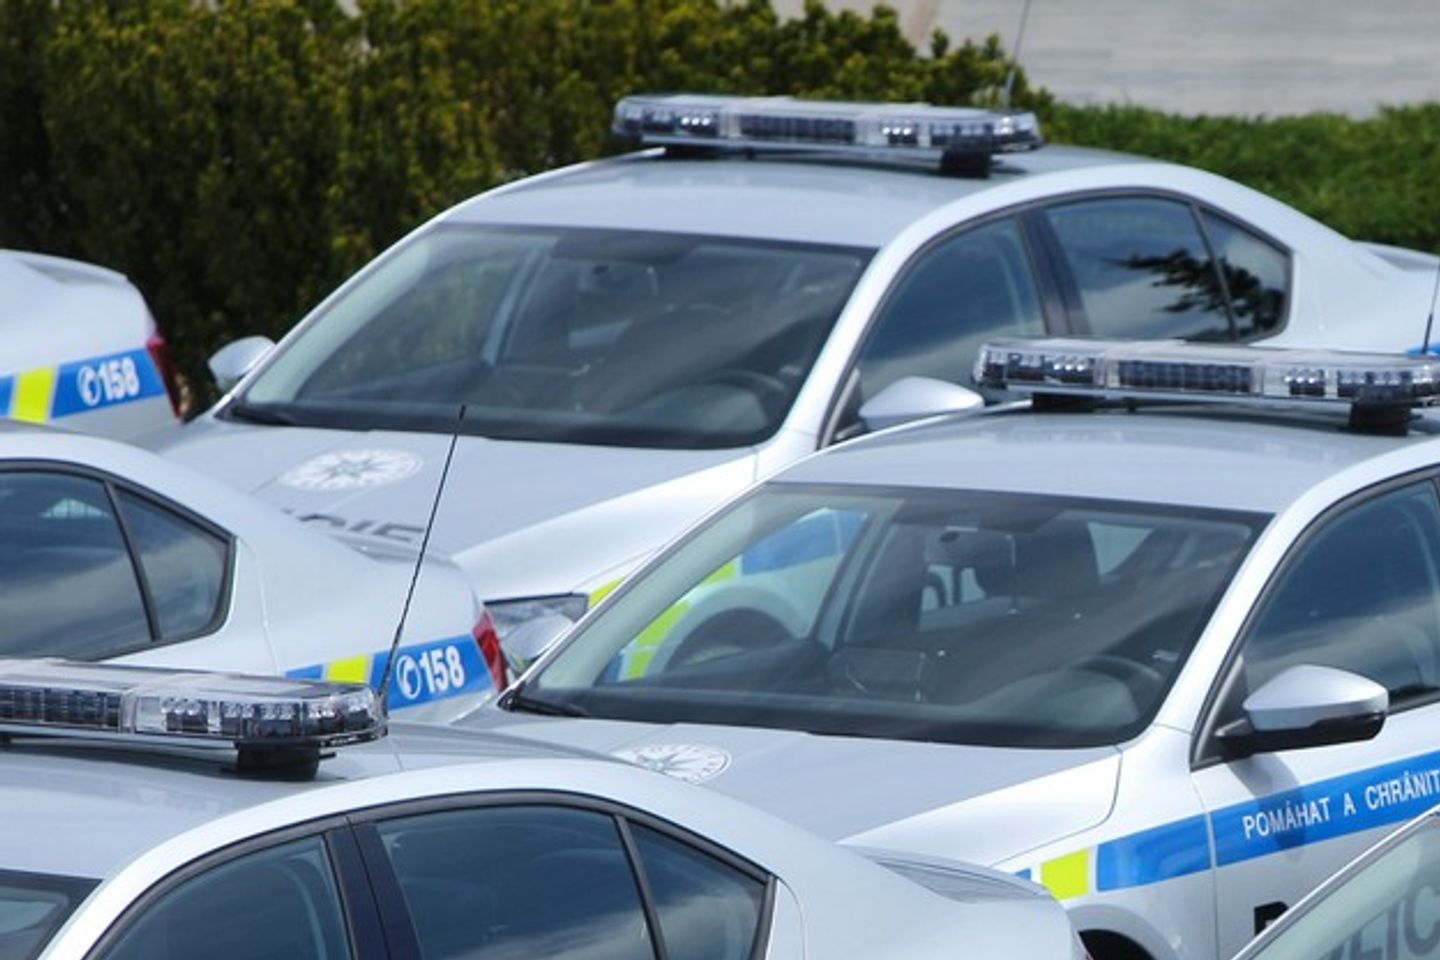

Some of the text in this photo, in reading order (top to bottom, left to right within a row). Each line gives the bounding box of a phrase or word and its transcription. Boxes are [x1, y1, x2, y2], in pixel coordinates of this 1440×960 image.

[98, 356, 140, 401] 158
[419, 645, 465, 694] 158
[1242, 769, 1440, 840] POMÁHAT A CHRÁNIT
